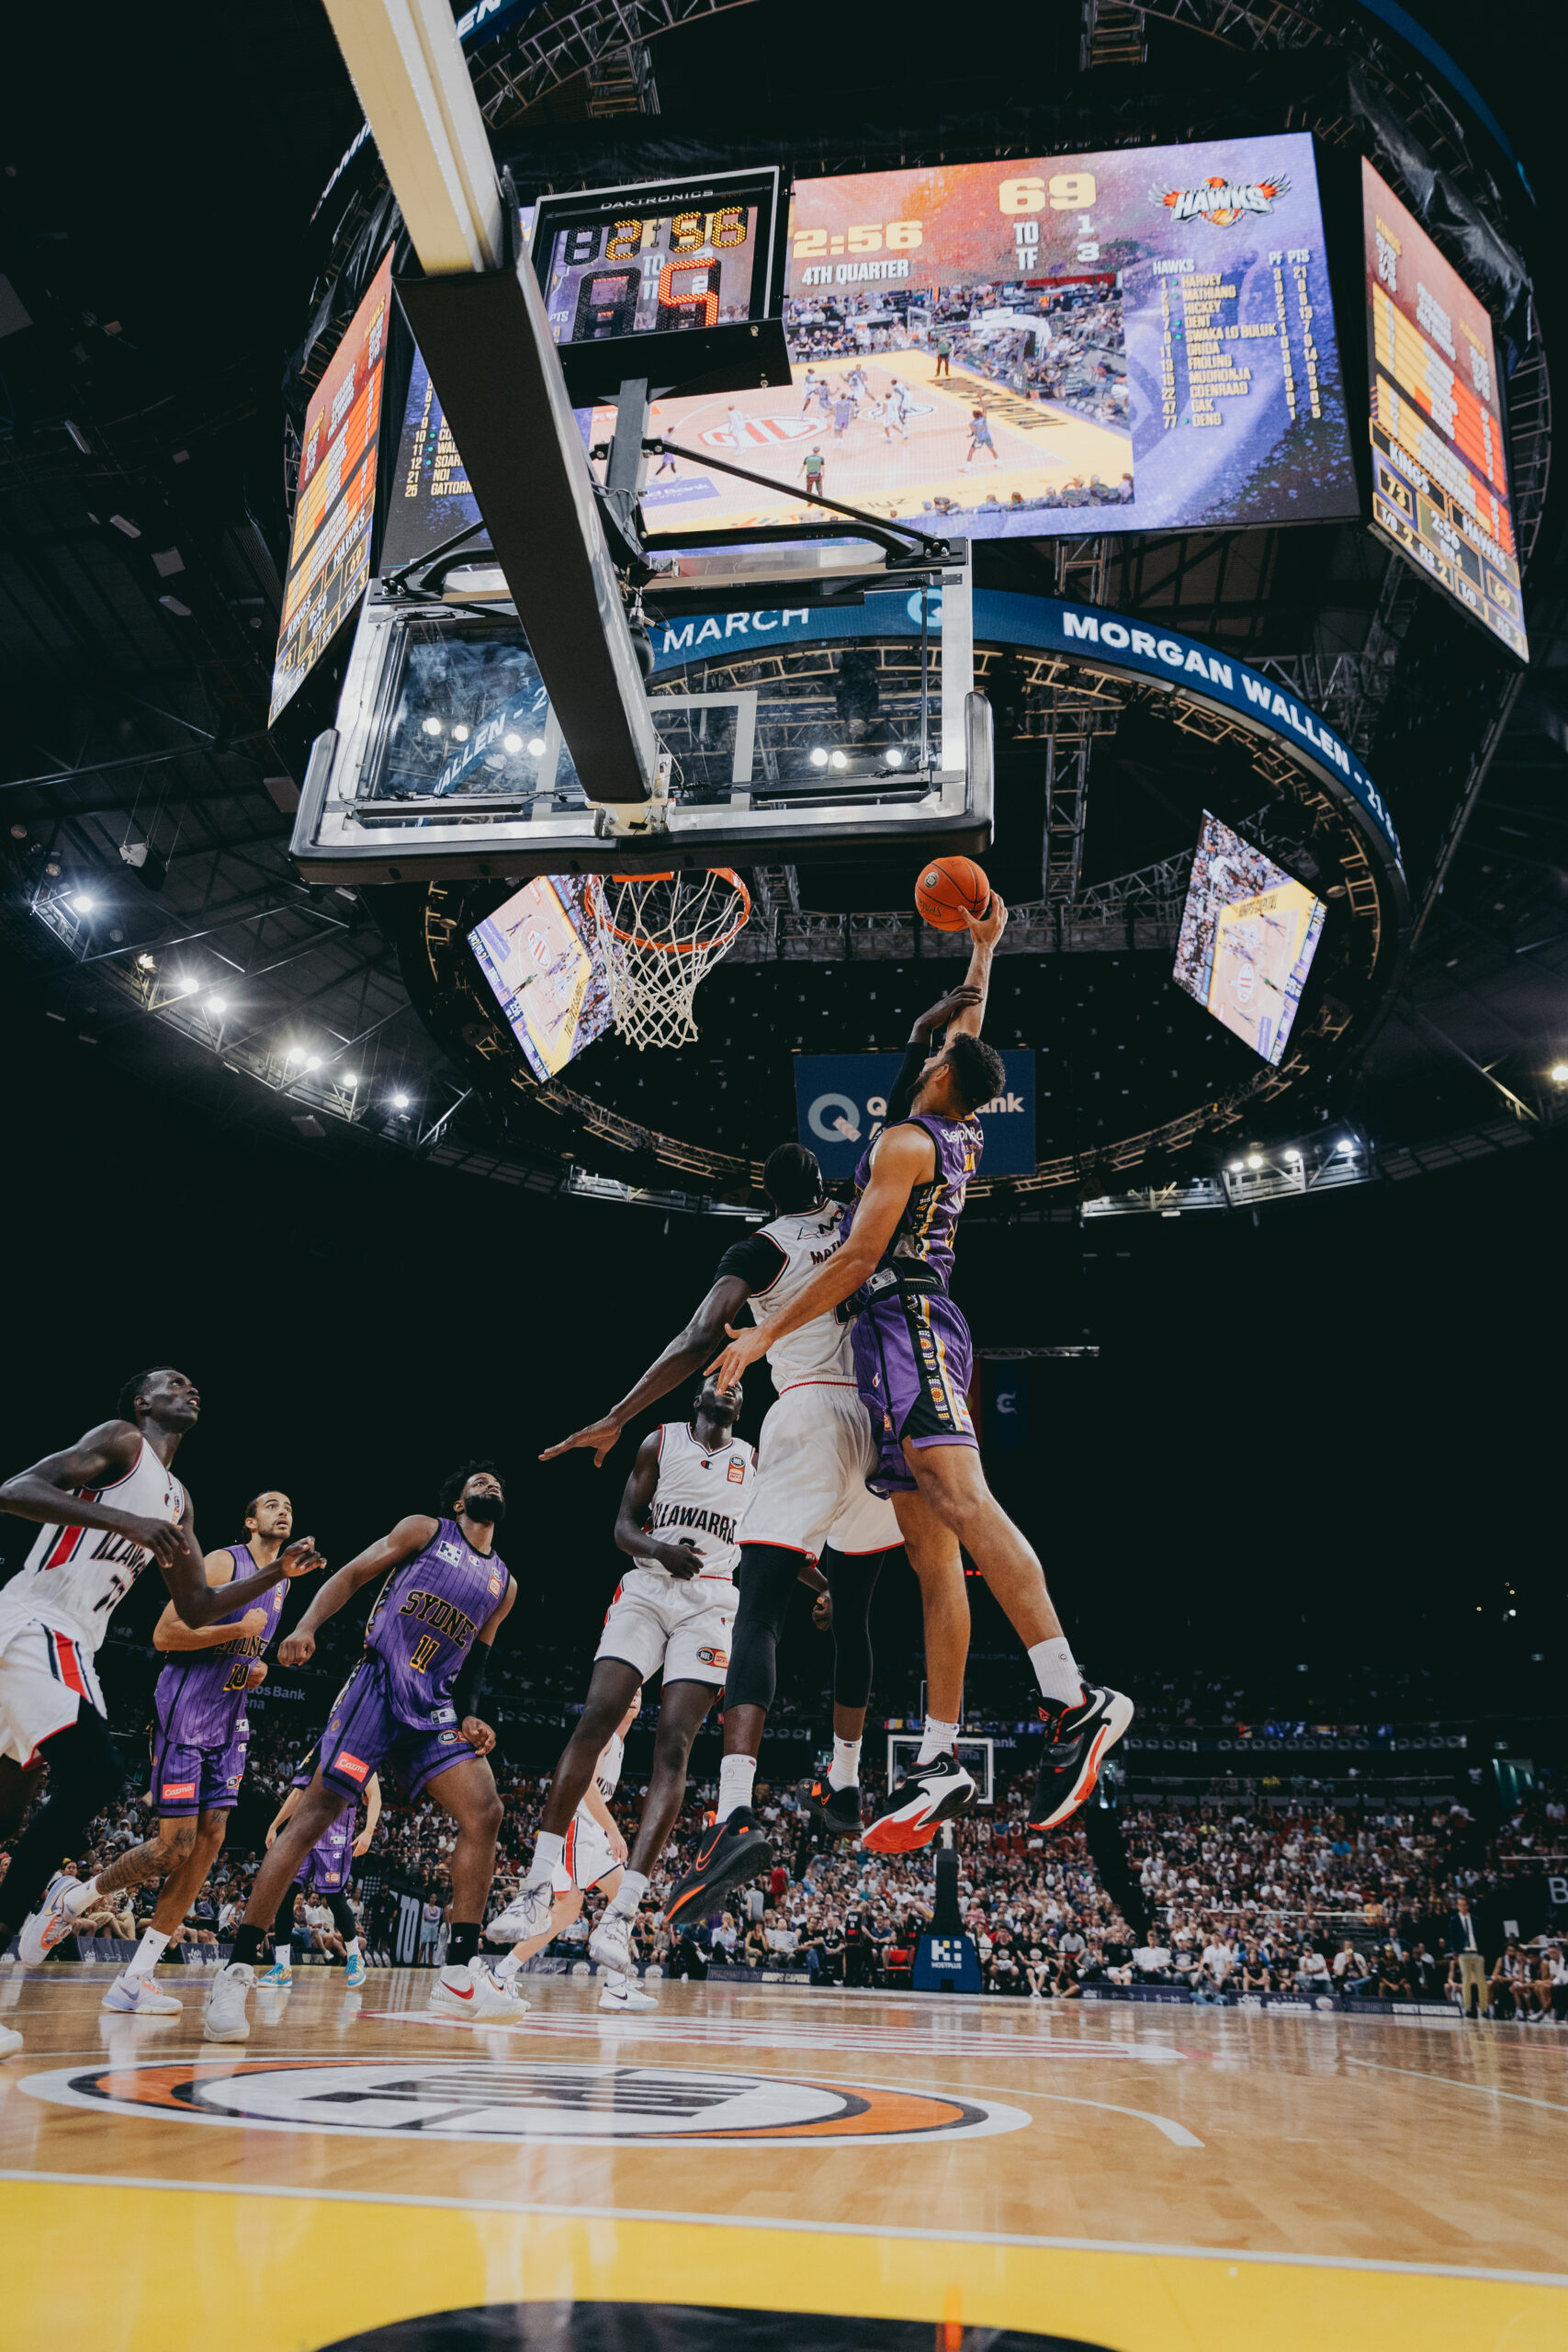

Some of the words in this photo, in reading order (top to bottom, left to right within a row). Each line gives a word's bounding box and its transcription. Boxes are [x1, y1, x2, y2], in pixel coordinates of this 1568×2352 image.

[601, 189, 714, 210] DAKTRONICS
[998, 172, 1097, 215] 69
[1171, 186, 1274, 221] HAWKS
[792, 220, 922, 259] 2:56
[1012, 221, 1040, 245] TO
[1077, 214, 1096, 234] 1
[1016, 246, 1038, 270] TF
[1077, 243, 1100, 263] 3
[1153, 258, 1194, 275] HAWKS
[1269, 251, 1283, 266] PF
[1287, 248, 1311, 264] PTS
[801, 265, 833, 286] 4TH
[835, 258, 909, 285] QUARTER
[1161, 277, 1167, 288] 1
[1181, 273, 1223, 288] HARVEY
[1293, 266, 1307, 279] 21
[1183, 300, 1222, 315] HICKEY
[423, 403, 431, 416] 7
[412, 443, 423, 456] 11
[415, 430, 427, 443] 10
[407, 470, 419, 483] 21
[433, 468, 451, 481] NOI
[411, 457, 423, 470] 12
[434, 454, 463, 469] SOAR
[1389, 440, 1430, 494] KINGS
[1462, 513, 1507, 571] HAWKS
[1430, 509, 1461, 550] 2:56
[348, 550, 362, 574] 69
[1403, 525, 1414, 548] 2
[1438, 560, 1448, 582] 2
[287, 593, 312, 641] KINGS
[333, 507, 366, 571] HAWKS
[662, 606, 809, 654] MARCH
[1063, 611, 1234, 691] MORGAN
[1240, 673, 1351, 775] WALLEN
[975, 1092, 1025, 1114] ank
[409, 1634, 440, 1674] 11
[223, 1663, 251, 1690] 10
[273, 1686, 306, 1701] Bank
